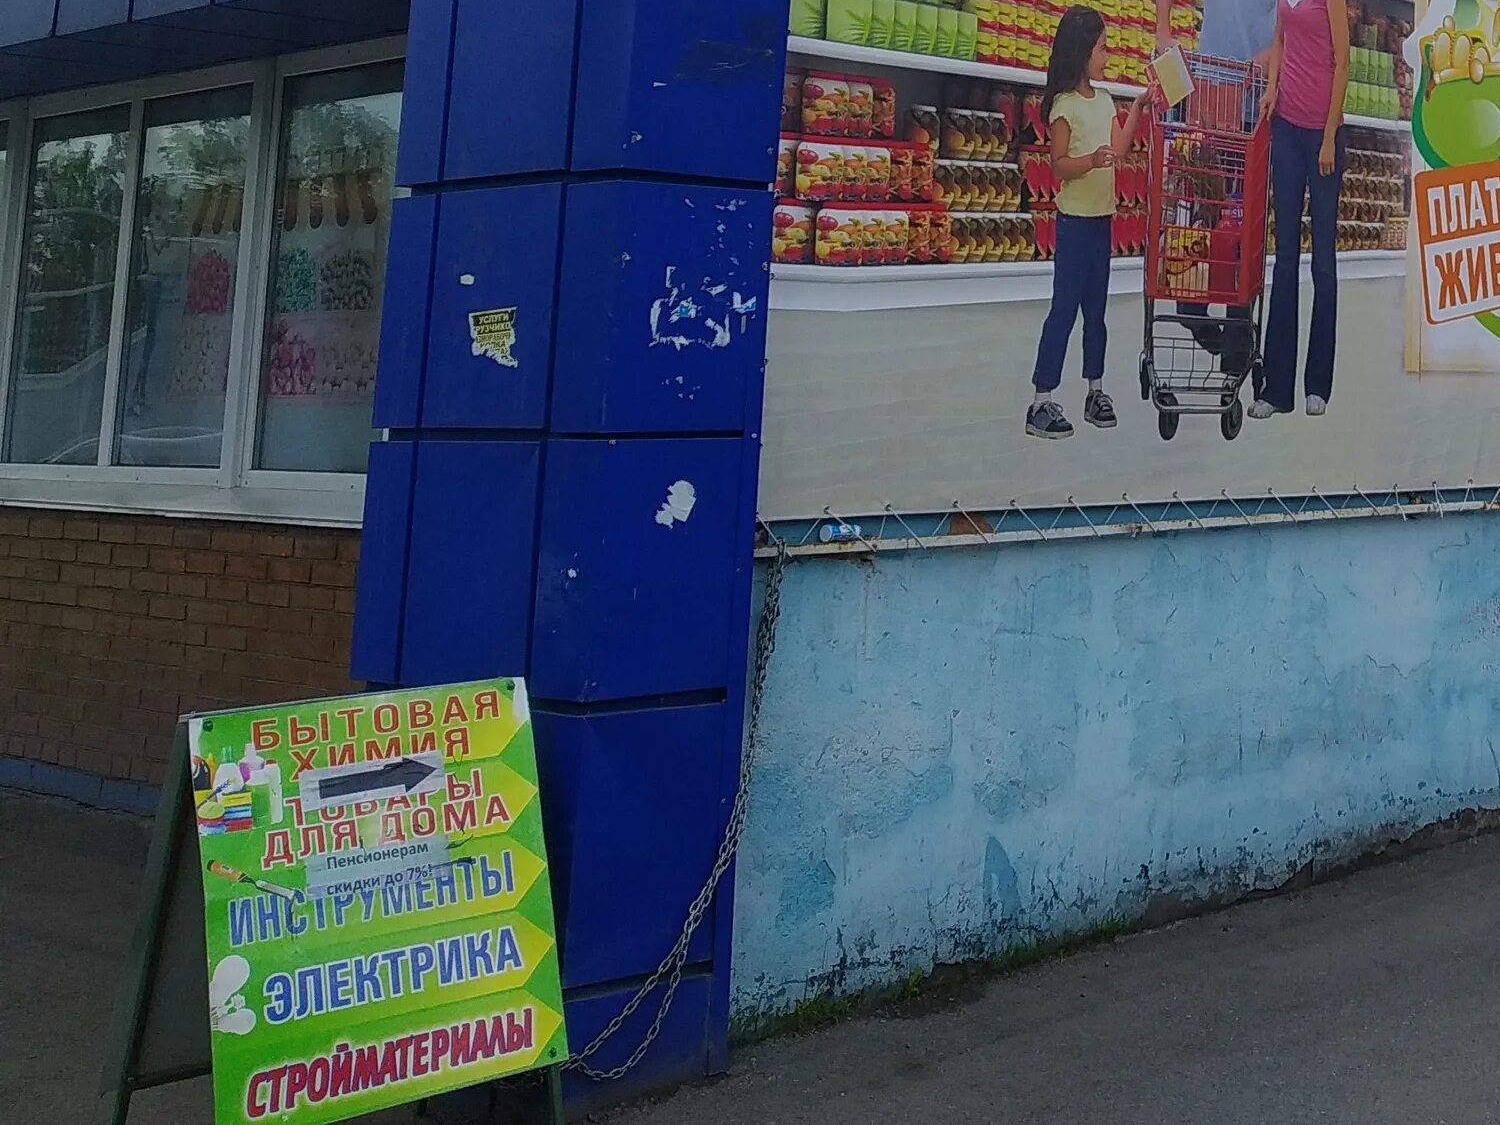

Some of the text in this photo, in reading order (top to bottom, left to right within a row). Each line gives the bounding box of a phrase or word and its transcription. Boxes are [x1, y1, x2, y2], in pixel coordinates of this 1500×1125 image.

[479, 313, 509, 324] УСЛУГИ
[251, 689, 500, 752] БЫТОВАЯ
[290, 727, 471, 782] ХИМИЯ
[262, 795, 511, 869] ДЛЯ ДОМА
[326, 841, 429, 870] Пенсионерам
[228, 851, 516, 948] ИНСТРУМЕНТЫ
[326, 874, 381, 896] скидки
[384, 871, 404, 888] до
[263, 924, 524, 1026] ЭЛЕКТРИКА
[245, 1006, 534, 1119] СТРОЙМАТЕРИАЛЫ
